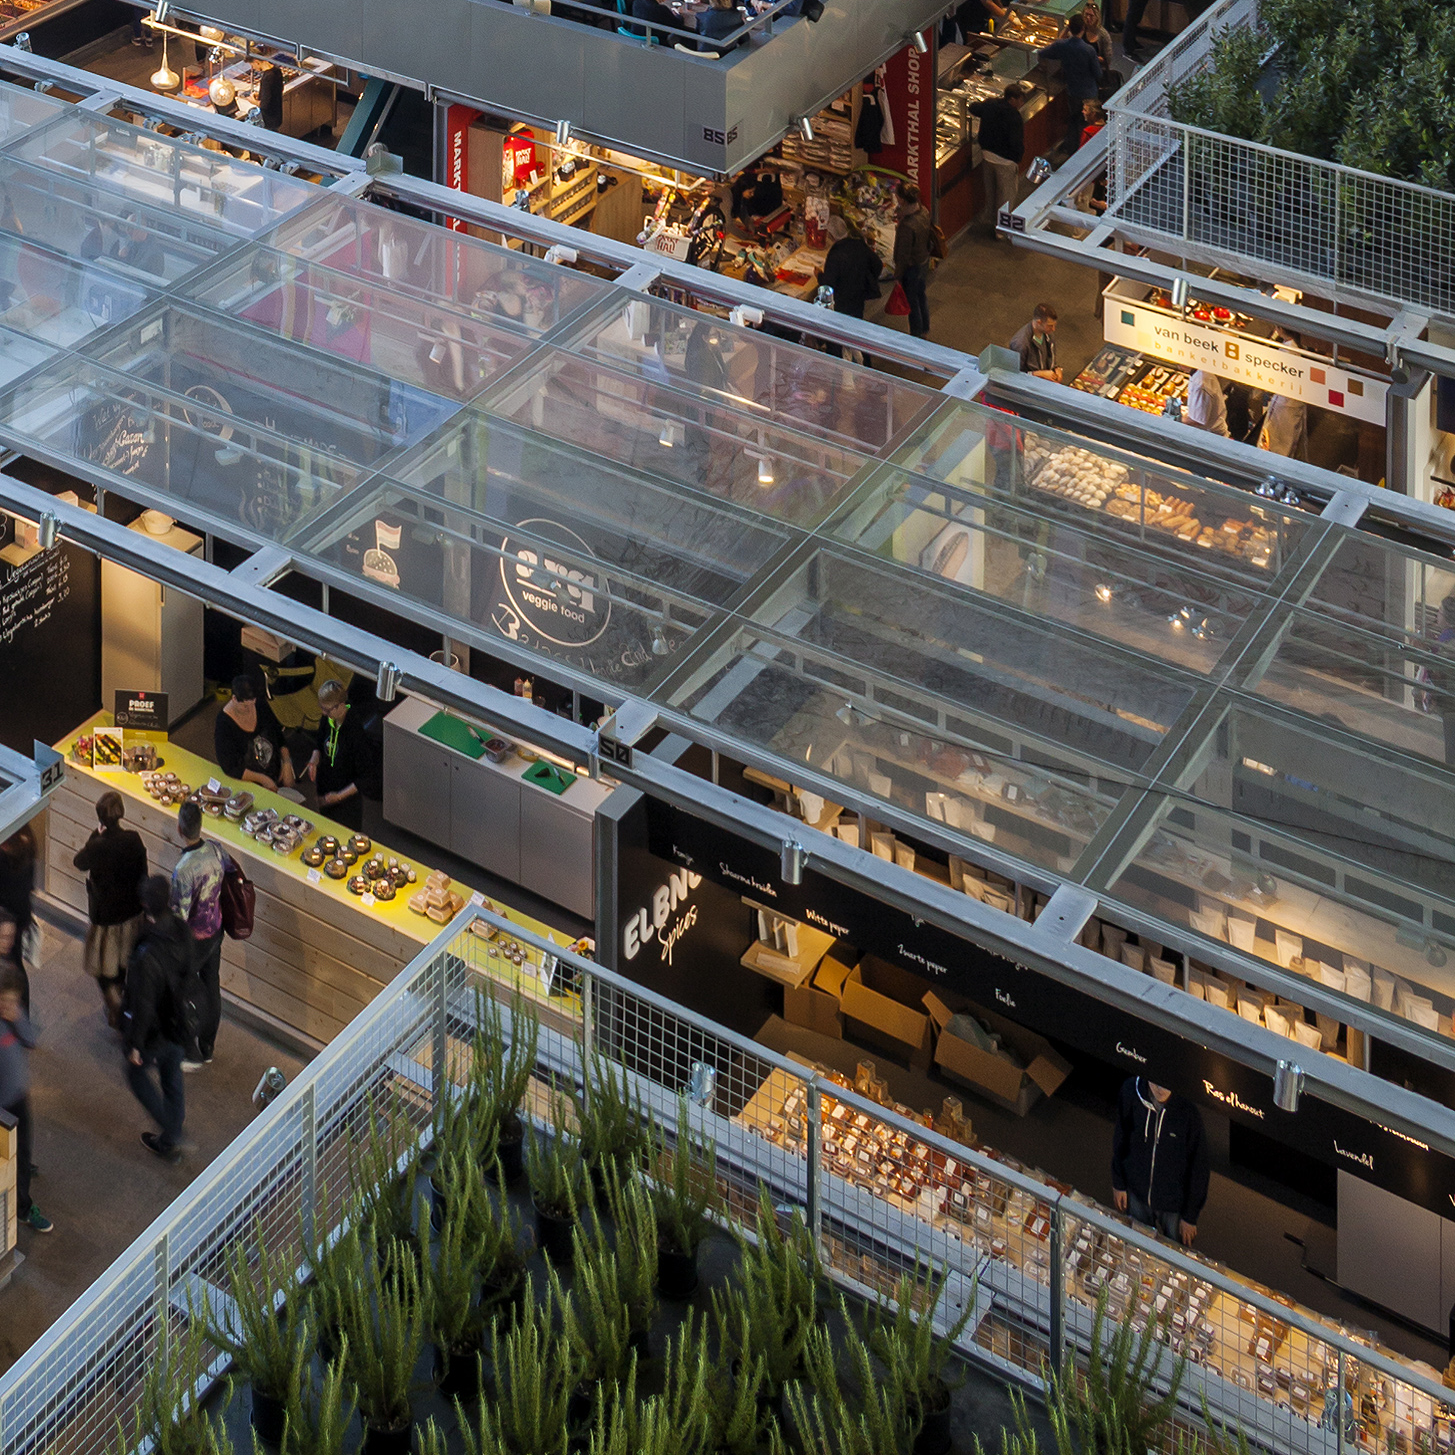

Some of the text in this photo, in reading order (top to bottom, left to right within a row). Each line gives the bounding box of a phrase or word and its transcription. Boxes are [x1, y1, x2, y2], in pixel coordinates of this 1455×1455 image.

[907, 47, 921, 185] ARKTHAL SHOP
[703, 127, 725, 145] 85
[999, 211, 1024, 232] 82
[1154, 325, 1180, 341] van
[1184, 331, 1219, 353] beek
[1245, 352, 1304, 379] specker
[1154, 341, 1303, 395] banketbakkerij
[522, 590, 585, 623] veggie food
[129, 699, 155, 709] PROEF
[42, 760, 63, 791] 31
[657, 904, 698, 966] Spices
[805, 908, 850, 936] Witte peper
[926, 959, 948, 975] peper
[1115, 1041, 1147, 1064] Gember
[1202, 1079, 1225, 1101] Ras
[1333, 1139, 1374, 1170] Lavendel
